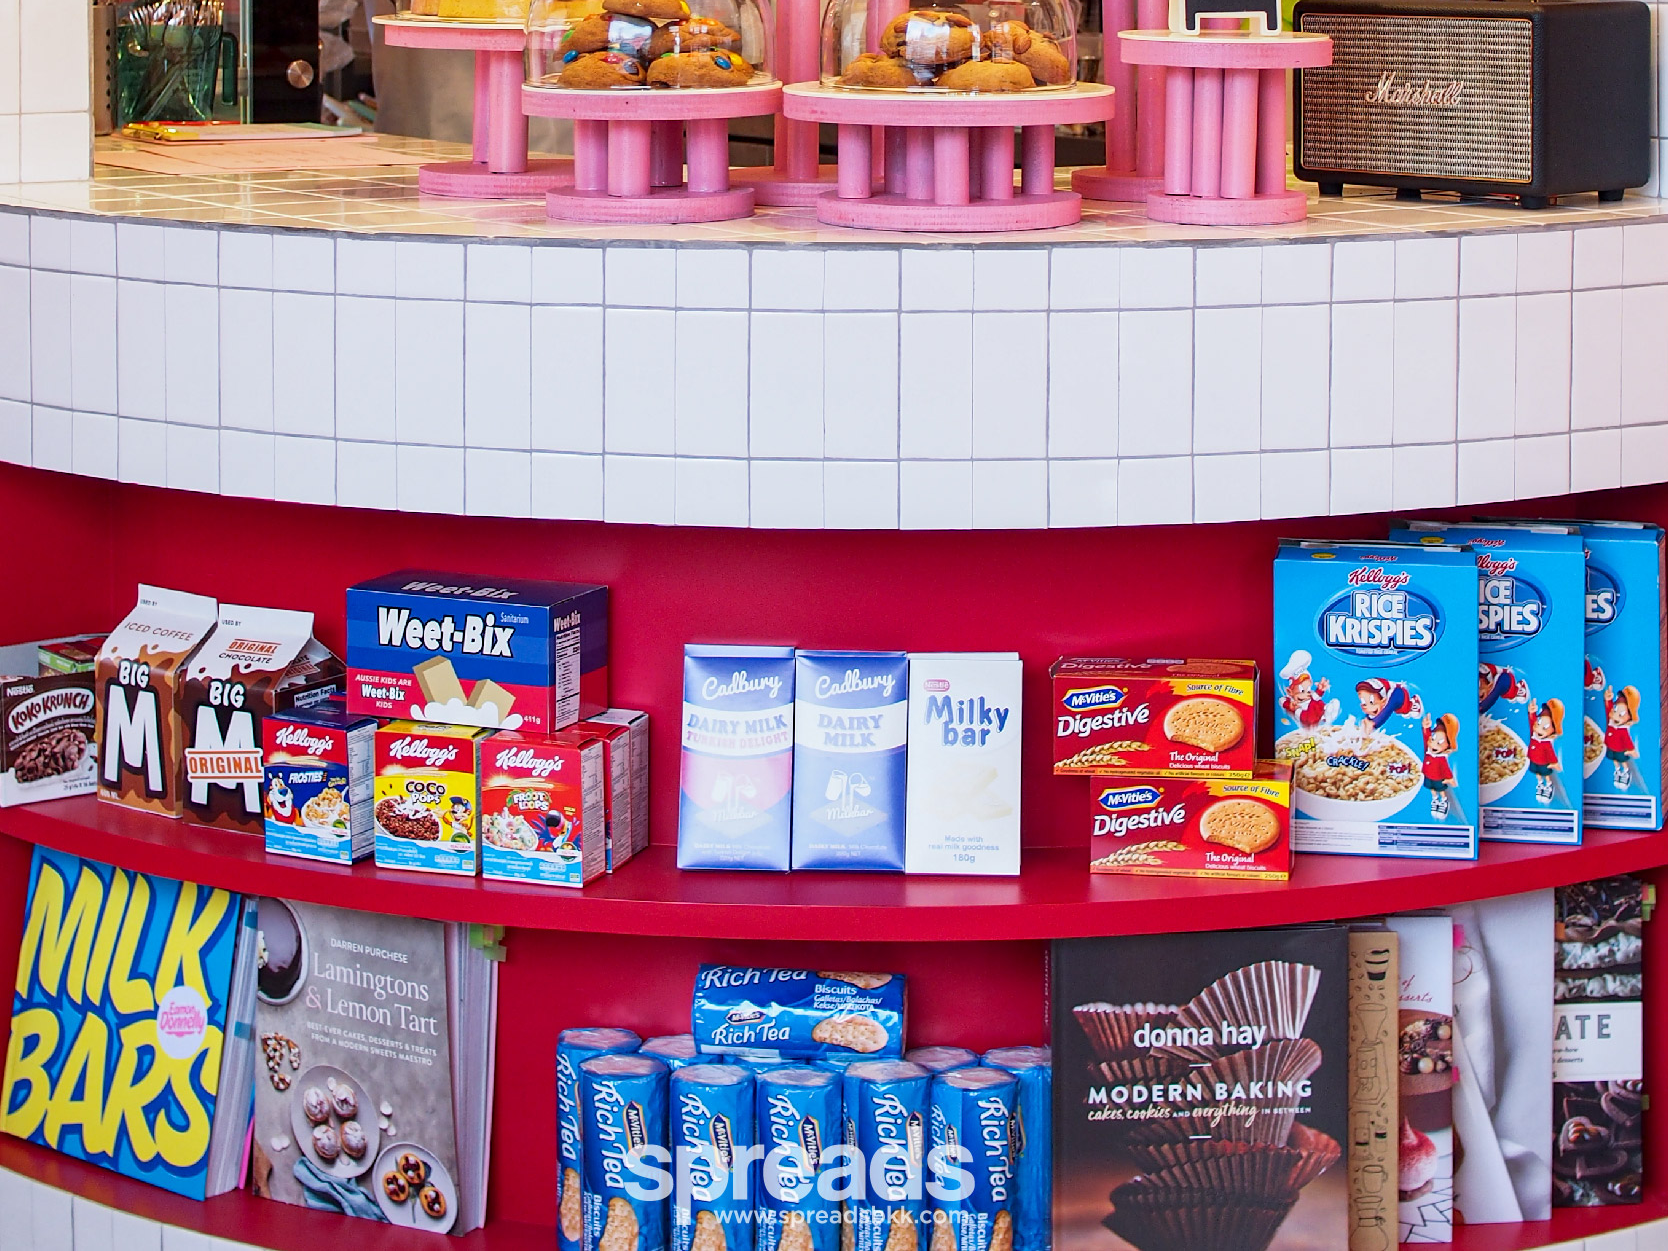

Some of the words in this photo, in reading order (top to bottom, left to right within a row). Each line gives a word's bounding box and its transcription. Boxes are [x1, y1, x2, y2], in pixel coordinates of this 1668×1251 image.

[1366, 71, 1464, 106] Marshall
[401, 581, 519, 599] Weet-Bix
[1349, 567, 1409, 590] Kellogg's
[500, 612, 530, 625] Sanitarium
[1355, 593, 1406, 618] RICE
[1479, 604, 1538, 631] SPIES
[124, 622, 151, 634] ICED
[152, 626, 194, 642] COFFEE
[377, 607, 515, 657] Weet-Bix
[553, 610, 581, 632] Weet-Bix
[1329, 615, 1431, 646] KRISPIES
[218, 652, 272, 664] CHOCOLATE
[228, 641, 278, 654] ORIGINAL
[118, 660, 149, 688] BIG
[355, 674, 380, 684] AUSSIE
[380, 676, 397, 685] KIDS
[398, 677, 412, 687] ARE
[702, 670, 783, 701] Cadbury
[815, 668, 896, 699] Cadbury
[209, 681, 245, 708] BIG
[361, 684, 405, 701] Weet-Bix
[1072, 688, 1117, 707] McVitie's
[1186, 683, 1212, 692] Source
[1213, 682, 1223, 692] of
[1224, 684, 1244, 696] Fibre
[11, 701, 42, 730] KOKO
[42, 692, 90, 716] KRUNCH
[376, 701, 393, 709] KIDS
[925, 694, 1010, 734] Milky
[523, 715, 541, 725] 411g
[687, 713, 739, 735] DAIRY
[745, 713, 788, 734] MILK
[817, 713, 884, 731] DAIRY
[942, 720, 992, 747] bar
[1057, 702, 1151, 738] Digestive
[104, 684, 163, 792] M
[276, 725, 334, 755] Kellogg's
[390, 736, 459, 765] Kellogg's
[686, 731, 738, 748] TURKISH
[739, 730, 788, 748] DELIGHT
[823, 732, 877, 747] MILK
[1286, 736, 1317, 757] SNAP!
[188, 756, 262, 774] ORIGINAL
[495, 747, 564, 776] Kellogg's
[1169, 752, 1184, 762] The
[1185, 752, 1219, 764] Original
[1326, 756, 1370, 771] CRACKLE!
[1389, 762, 1411, 774] POP!
[288, 771, 323, 784] FROSTIES
[1223, 784, 1249, 793] Source
[1250, 783, 1260, 793] of
[1261, 786, 1280, 798] Fibre
[513, 790, 550, 804] FROOT
[519, 801, 549, 812] LOOPS
[1107, 789, 1153, 807] McVitie's
[1093, 802, 1186, 837] Digestive
[945, 835, 966, 843] Made
[967, 835, 984, 843] with
[962, 844, 1000, 852] goodness
[953, 854, 976, 863] 180g
[1205, 853, 1220, 863] The
[1221, 854, 1255, 865] Original
[15, 862, 229, 1014] MILK
[331, 938, 363, 956] DARREN
[365, 944, 408, 963] PURCHESE
[313, 952, 429, 1001] Lamingtons
[701, 965, 761, 989] Rich
[762, 967, 808, 982] Tea
[814, 984, 857, 995] Biscuits
[161, 1012, 205, 1034] Donnelly
[305, 985, 322, 1009] &
[327, 988, 392, 1026] Lemon
[394, 1003, 439, 1036] Tart
[307, 1021, 342, 1036] BEST-EVER
[368, 1035, 403, 1049] DESSERTS
[404, 1043, 410, 1051] &
[411, 1045, 437, 1056] TREATS
[711, 1021, 755, 1045] Rich
[756, 1018, 790, 1041] Tea
[1133, 1022, 1214, 1048] donna
[1221, 1020, 1267, 1049] hay
[1555, 1014, 1611, 1041] ATE
[311, 1032, 330, 1044] FROM
[338, 1040, 369, 1052] MODERN
[370, 1046, 397, 1059] SWEETS
[398, 1053, 432, 1066] MAESTRO
[0, 1007, 224, 1167] BARS
[557, 1053, 577, 1113] Rich
[1088, 1083, 1203, 1104] MODERN
[1215, 1080, 1313, 1100] BAKING
[592, 1080, 625, 1141] Rich
[679, 1093, 711, 1154] Rich
[872, 1094, 909, 1154] Rich
[1126, 1103, 1171, 1120] cookies
[1192, 1101, 1259, 1128] everything
[1261, 1107, 1271, 1115] IN
[1272, 1106, 1312, 1114] BETWEEN
[560, 1114, 581, 1160] Tea
[768, 1094, 801, 1156] Rich
[978, 1097, 1009, 1157] Rich
[601, 1142, 635, 1188] Tea
[883, 1156, 917, 1201] Tea
[688, 1156, 723, 1202] Tea
[776, 1157, 810, 1203] Tea
[988, 1156, 1013, 1202] Tea
[593, 1194, 603, 1238] Biscuits
